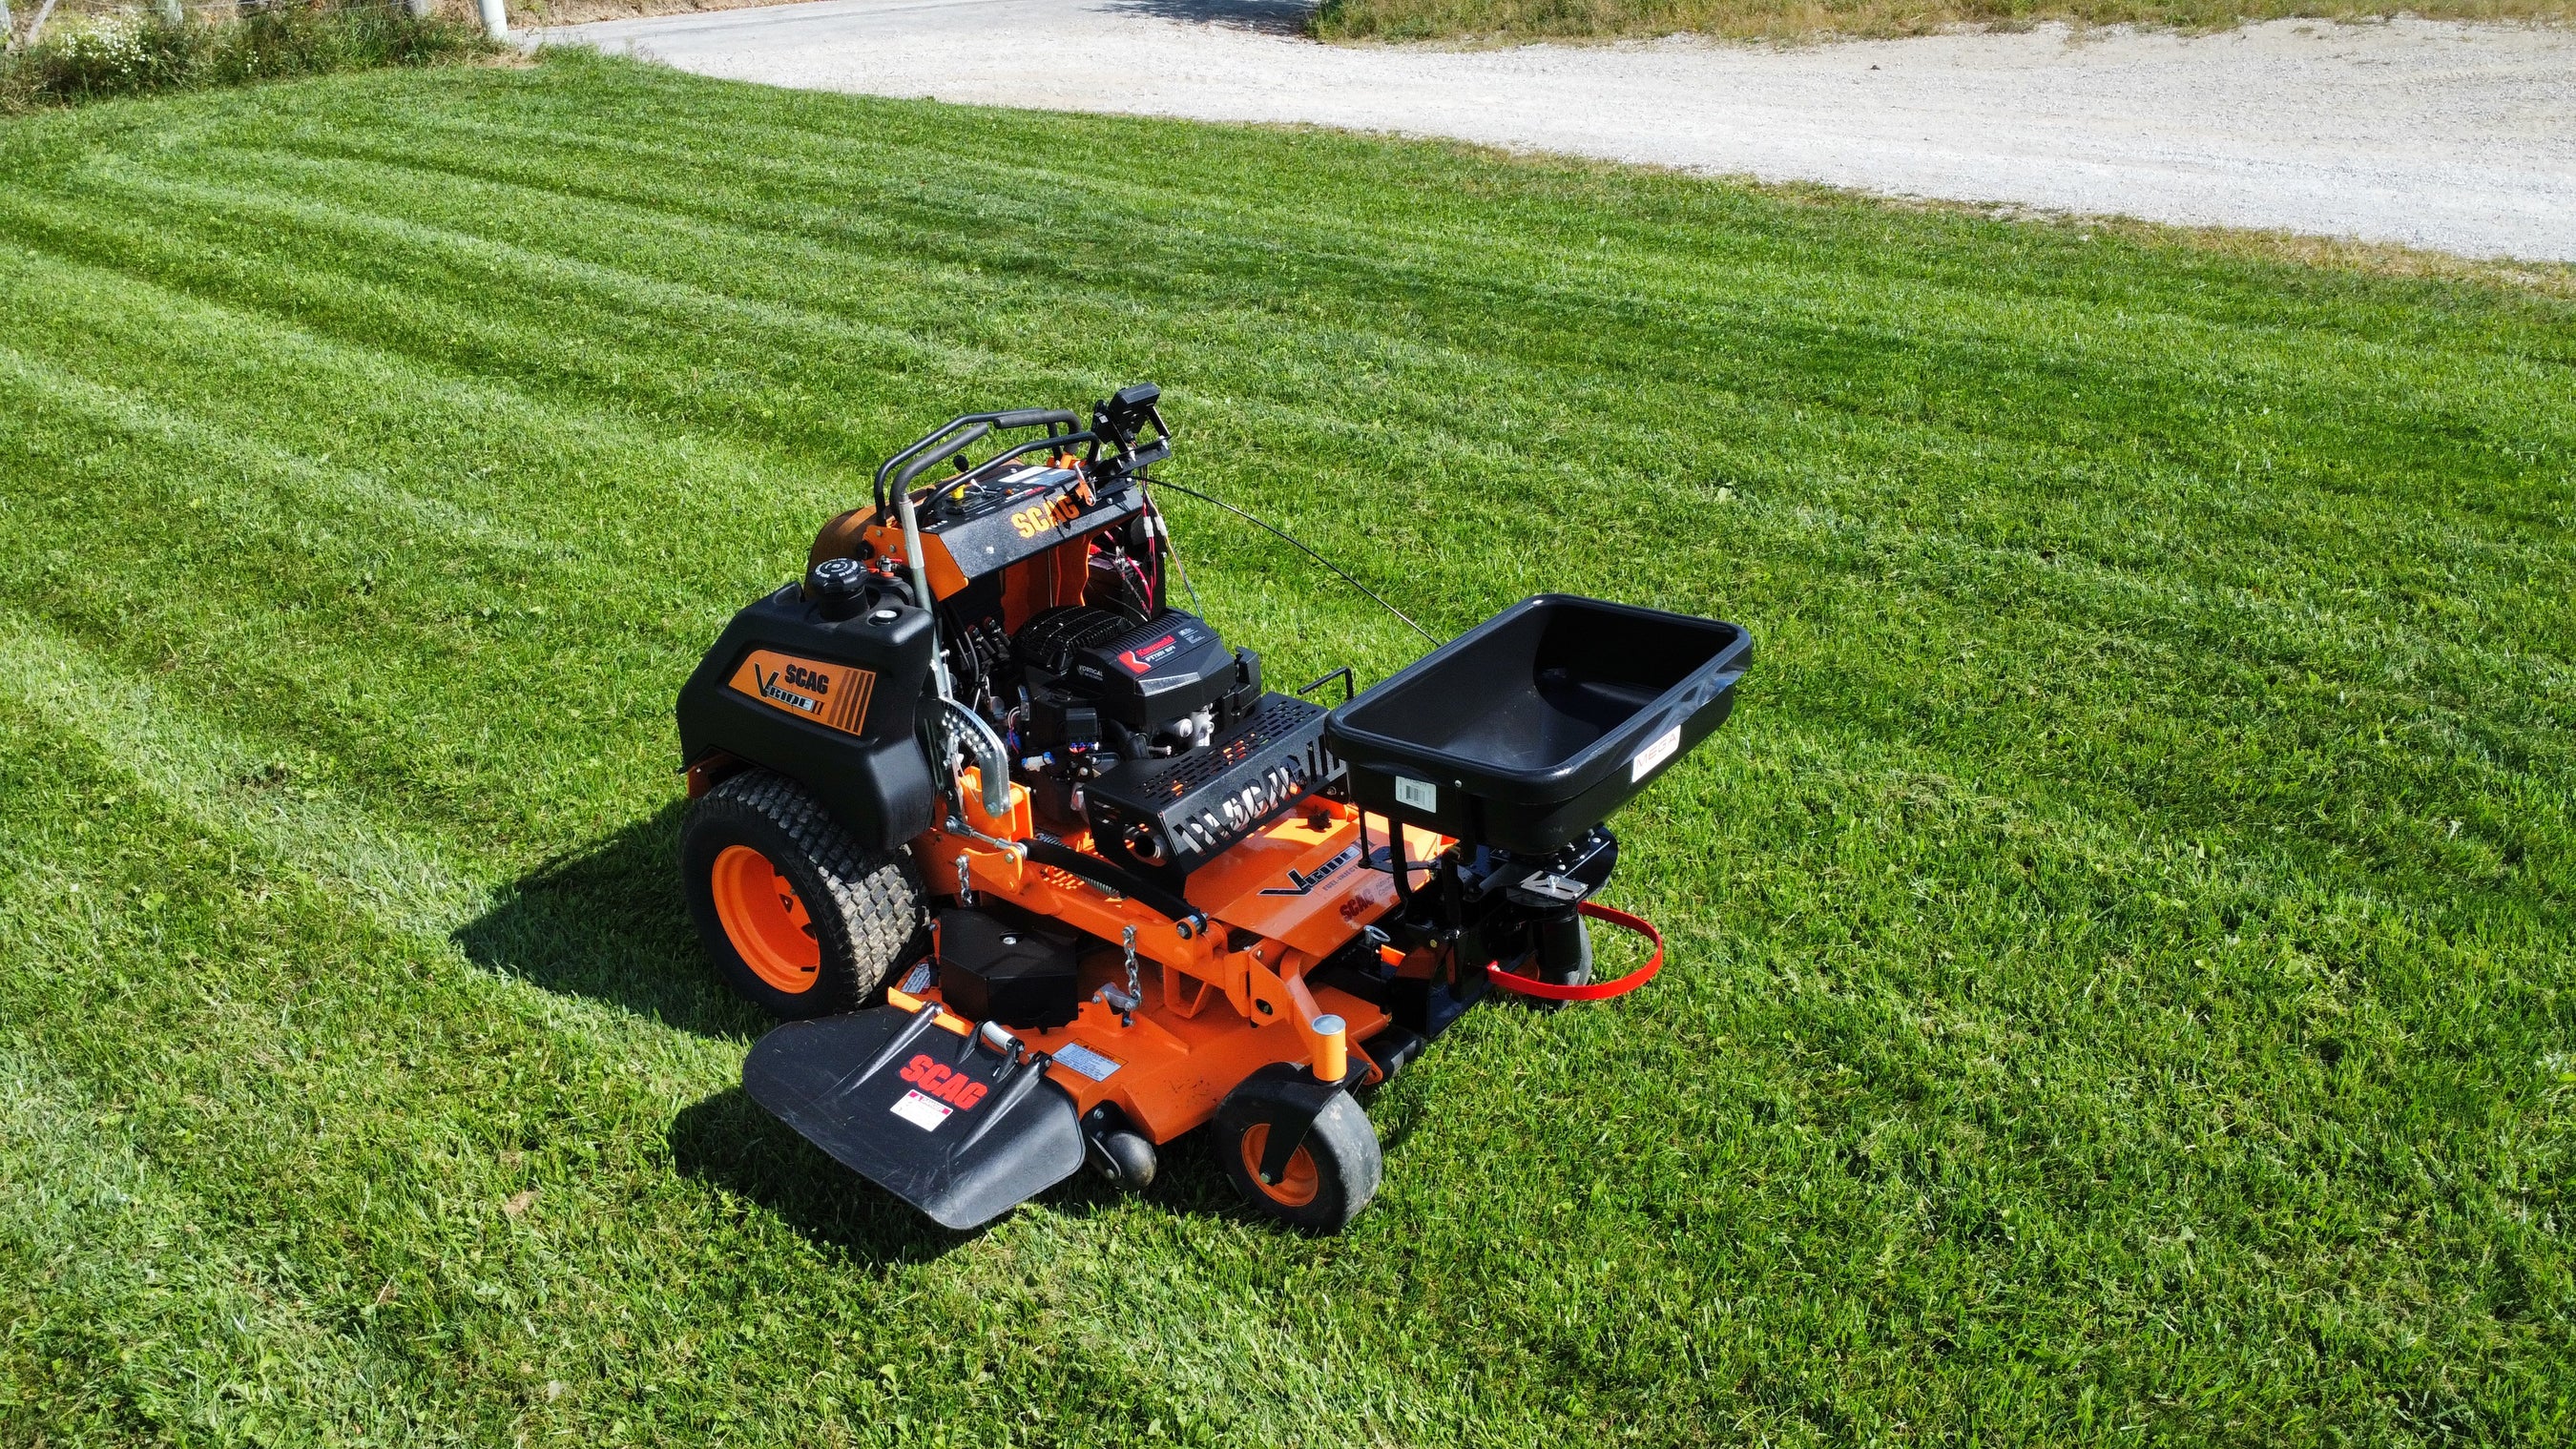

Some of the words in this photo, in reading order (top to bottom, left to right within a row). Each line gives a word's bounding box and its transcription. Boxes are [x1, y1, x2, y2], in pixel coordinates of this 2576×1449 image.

[1010, 494, 1081, 539] SCAG
[784, 663, 830, 695] SCAG
[1636, 733, 1677, 770] MEGA
[1339, 887, 1375, 922] SCAG
[900, 1054, 988, 1110] SCAG
